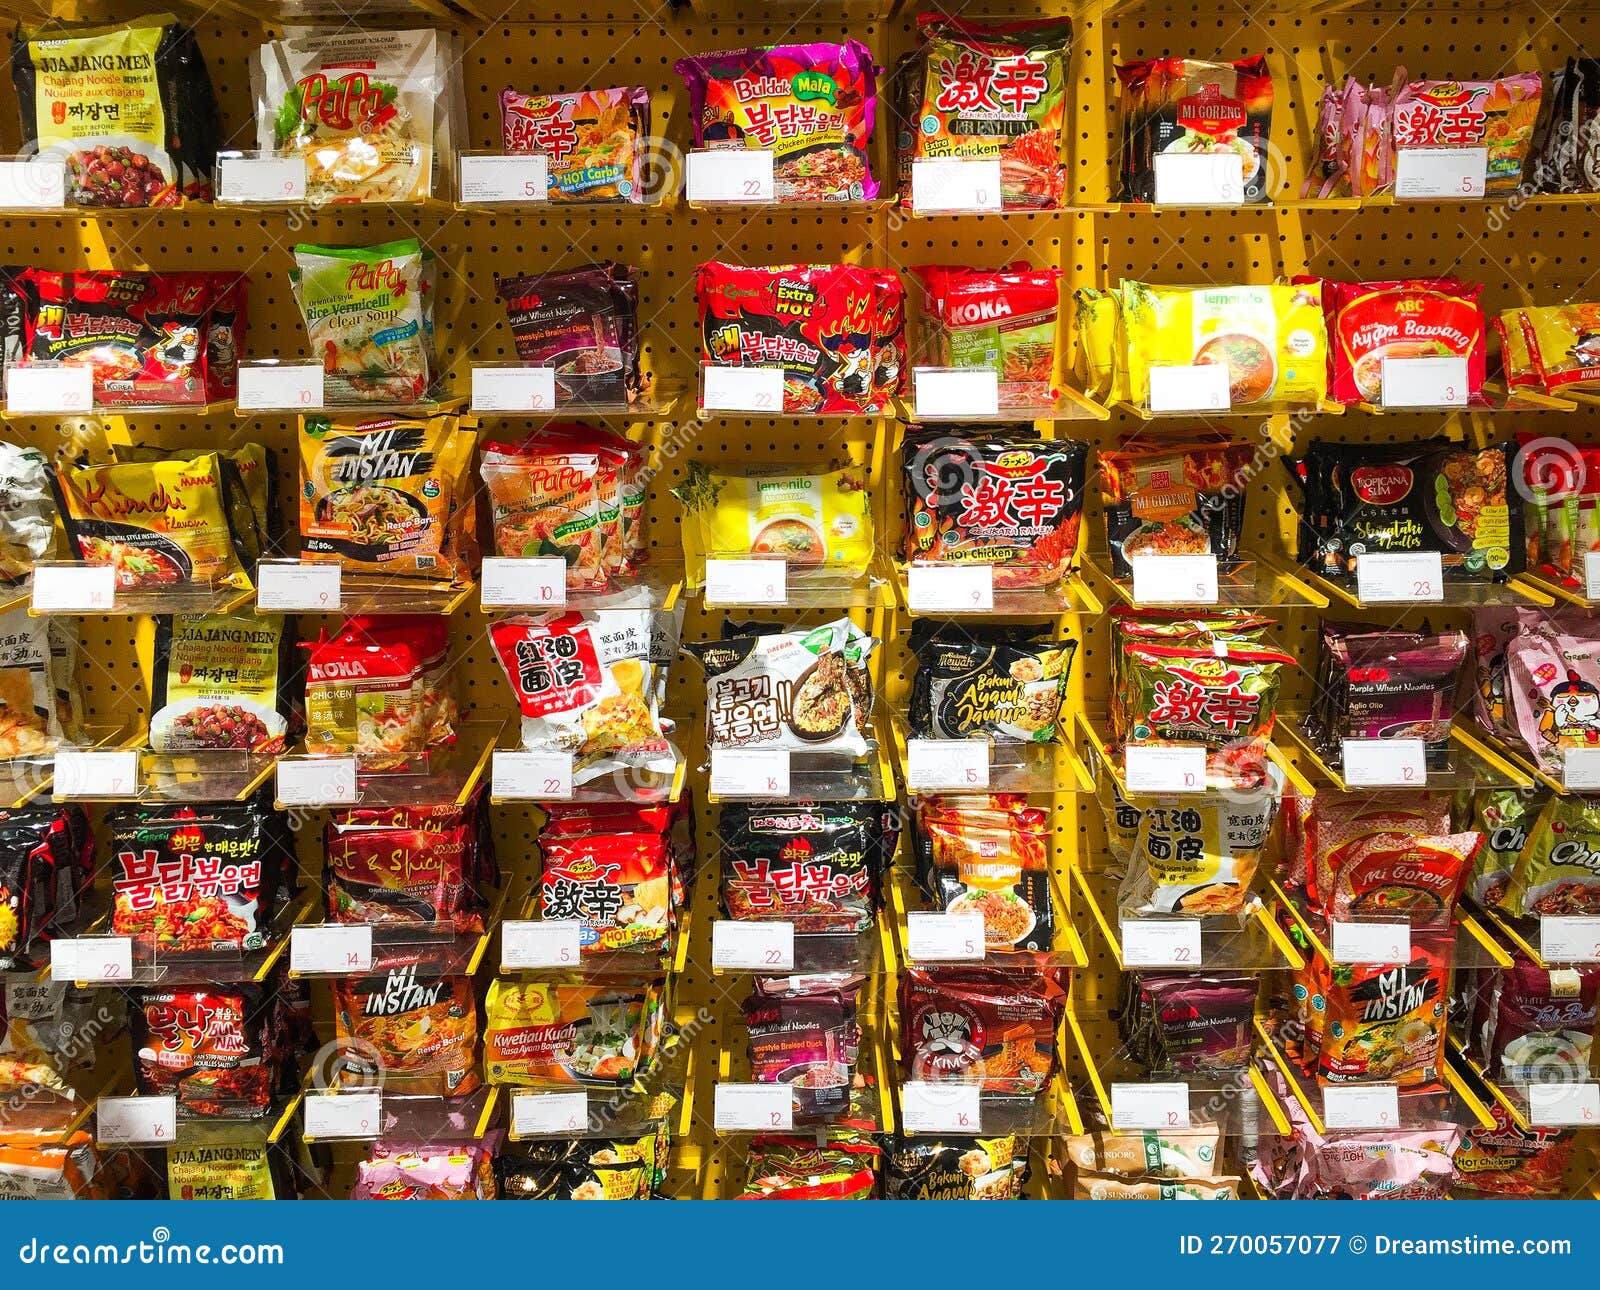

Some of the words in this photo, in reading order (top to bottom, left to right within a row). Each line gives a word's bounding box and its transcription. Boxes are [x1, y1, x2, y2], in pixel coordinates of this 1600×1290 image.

[40, 55, 115, 73] JJAJANG
[117, 54, 152, 71] MEN
[43, 75, 84, 88] Chajang
[86, 74, 121, 85] Noodle
[734, 76, 791, 102] Buldak
[798, 78, 831, 94] Mala
[936, 52, 1048, 112] 激辛
[44, 88, 83, 98] Nouilles
[86, 89, 102, 97] aux
[106, 88, 145, 99] chajang
[68, 102, 120, 121] 짜장면
[1182, 104, 1197, 119] MI
[1198, 104, 1241, 119] GORENG
[744, 103, 845, 146] 불닭볶음면
[1394, 106, 1486, 144] 激辛
[502, 119, 578, 161] 激辛
[778, 139, 804, 151] Chicken
[924, 138, 949, 151] Extra
[928, 147, 953, 158] HOT
[954, 144, 998, 157] Chicken
[562, 171, 584, 185] HOT
[587, 166, 619, 181] Carbo
[347, 260, 402, 290] PaPa
[111, 279, 145, 291] Extra
[779, 278, 809, 291] Buldak
[309, 295, 336, 307] Oriental
[337, 293, 354, 302] Style
[778, 288, 815, 302] Extra
[306, 305, 330, 319] Rice
[331, 294, 391, 316] Vermicelli
[537, 309, 555, 321] Wheat
[556, 305, 585, 317] Noodles
[776, 300, 812, 316] HOT
[950, 296, 1012, 324] KOKA
[1394, 299, 1424, 313] ABC
[329, 312, 364, 328] Clear
[366, 308, 399, 324] Soup
[572, 324, 591, 334] Duck
[1352, 323, 1399, 350] Ayam
[1404, 320, 1471, 348] Bawang
[1360, 322, 1379, 332] Rasa
[50, 340, 67, 352] HOT
[68, 336, 96, 347] Chicken
[741, 332, 818, 362] 불닭볶음면
[106, 382, 134, 391] KOREA
[359, 430, 396, 457] MI
[338, 452, 420, 479] INSTAN
[1002, 457, 1031, 466] ラーメン
[180, 476, 214, 487] MAMA
[529, 467, 584, 493] PaPa
[756, 478, 812, 492] lemonilo
[1357, 476, 1409, 489] TROPICANA
[85, 478, 186, 516] Kimchi
[1368, 486, 1391, 497] SLIM
[957, 475, 1064, 527] 激辛
[1136, 498, 1149, 510] MI
[1151, 493, 1191, 507] GORENG
[387, 520, 412, 531] Resep
[414, 517, 438, 526] Baru!
[1019, 527, 1054, 535] RAMEN
[1354, 518, 1423, 541] Shirataki
[1376, 534, 1421, 549] Noodles
[946, 550, 967, 561] HOT
[971, 548, 1011, 559] Chicken
[178, 628, 242, 643] JJAJANG
[244, 631, 275, 644] MEN
[176, 643, 211, 653] Chajang
[213, 645, 245, 653] Noodle
[516, 634, 577, 667] 红油
[176, 653, 209, 662] Nouilles
[210, 655, 226, 663] aux
[228, 655, 262, 666] chajang
[193, 667, 239, 683] 짜장면
[311, 660, 368, 680] KOKA
[520, 660, 584, 695] 面皮
[977, 673, 1013, 689] Bakmi
[1350, 683, 1374, 694] Purple
[1375, 682, 1402, 692] Wheat
[1404, 682, 1435, 691] Noodles
[311, 690, 352, 701] CHICKEN
[716, 675, 771, 707] 불고기
[955, 683, 1019, 710] Ayam
[1149, 681, 1260, 730] 激辛
[1349, 702, 1371, 710] Aglio
[957, 704, 1027, 731] Jamur
[1227, 814, 1265, 827] 宽面皮
[1147, 832, 1205, 861] 面皮
[390, 849, 444, 880] Spicy
[113, 850, 261, 911] 불닭볶음면
[728, 858, 869, 906] 불닭볶음면
[1362, 867, 1388, 887] Mi
[1392, 866, 1453, 890] Goreng
[542, 879, 623, 921] 激辛
[606, 931, 627, 942] HOT
[630, 928, 658, 939] Spicy
[385, 962, 420, 995] MI
[1378, 968, 1413, 998] MI
[365, 982, 443, 1015] INSTAN
[1364, 978, 1428, 1020] INSTAN
[147, 1003, 214, 1050] 불낙
[208, 1021, 235, 1037] BUL
[792, 1021, 820, 1031] Noodles
[1210, 1017, 1237, 1025] Noodles
[418, 1043, 441, 1055] Resep
[442, 1032, 466, 1047] Baru!
[494, 1030, 544, 1047] Kwetiau
[545, 1024, 577, 1041] Kuah
[213, 1037, 249, 1052] NAK
[500, 1046, 519, 1056] Rasa
[519, 1045, 540, 1055] Ayam
[541, 1041, 571, 1051] Bawang
[933, 1045, 981, 1069] KIMCHI
[172, 1149, 236, 1165] JJAJANG
[236, 1148, 263, 1161] MEN
[1458, 1158, 1478, 1168] HOT
[1479, 1157, 1516, 1167] Chicken
[172, 1165, 207, 1176] Chajang
[207, 1164, 237, 1173] Noodle
[928, 1171, 964, 1189] Bakmi
